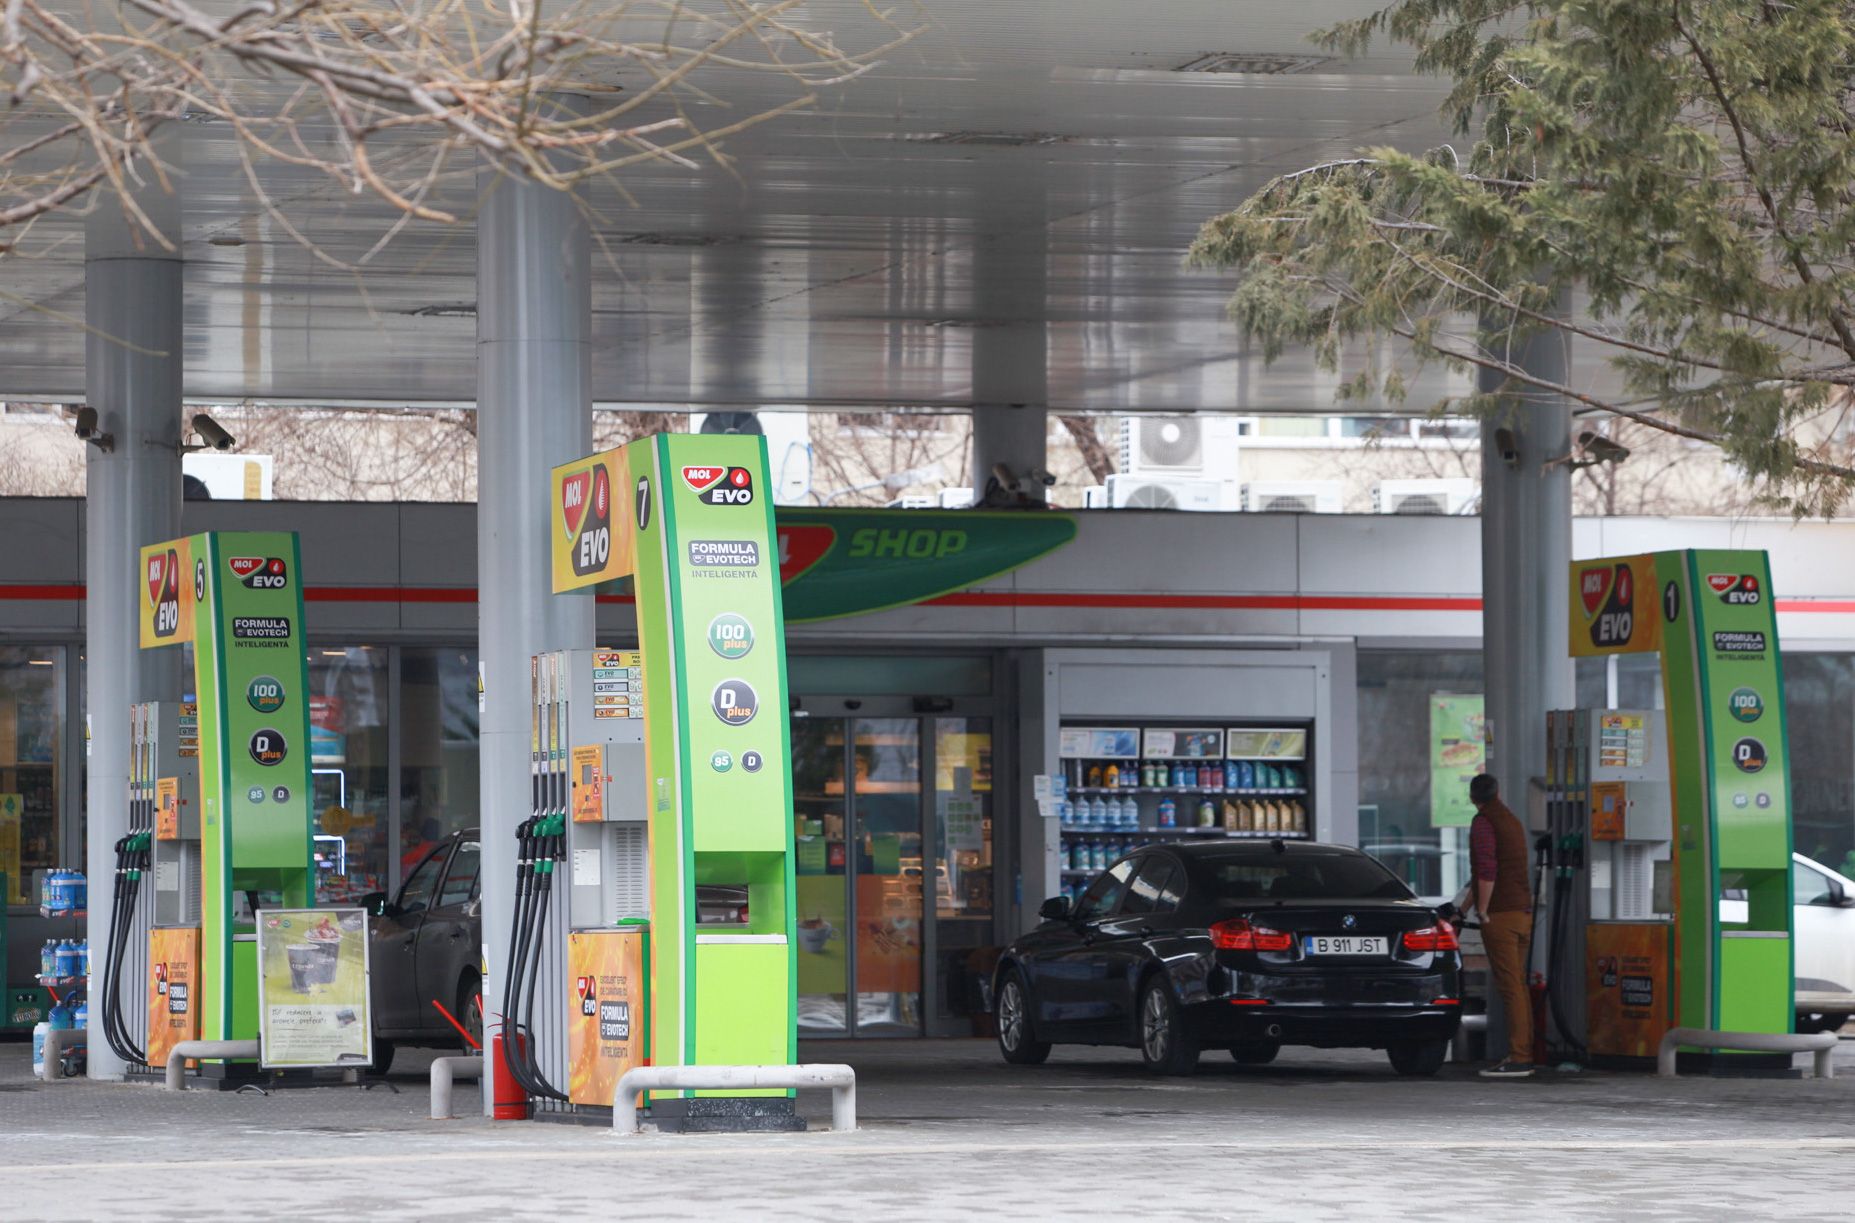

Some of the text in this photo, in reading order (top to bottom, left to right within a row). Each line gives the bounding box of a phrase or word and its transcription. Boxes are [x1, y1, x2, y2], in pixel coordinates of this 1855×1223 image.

[687, 469, 711, 479] MOL
[565, 480, 582, 509] MOL
[711, 489, 752, 503] EVO
[638, 480, 648, 527] 7
[580, 526, 609, 568] EVO
[691, 543, 755, 554] FORMULA
[849, 529, 968, 558] SHOP
[233, 560, 253, 569] MOL
[706, 555, 756, 564] EVOTECH
[195, 562, 205, 601] 5
[252, 576, 285, 588] EVO
[1667, 584, 1677, 621] 1
[1728, 591, 1758, 603] EVO
[159, 600, 178, 631] EVO
[235, 619, 287, 628] FORMULA
[1600, 614, 1632, 641] EVO
[716, 624, 744, 640] 100
[1715, 633, 1762, 642] FORMULA
[723, 640, 747, 650] plus
[254, 685, 276, 697] 100
[259, 697, 278, 705] plus
[720, 689, 736, 708] D
[1735, 696, 1756, 707] 100
[727, 706, 750, 718] plus
[256, 736, 269, 751] D
[260, 750, 281, 760] plus
[1738, 745, 1750, 760] D
[715, 756, 729, 767] 95
[748, 757, 755, 766] D
[250, 790, 262, 799] 95
[277, 790, 284, 799] D
[1318, 939, 1381, 952] B 911 JST
[584, 999, 596, 1014] EVO
[601, 1005, 628, 1021] FORMULA
[606, 1023, 629, 1036] EVOTECH
